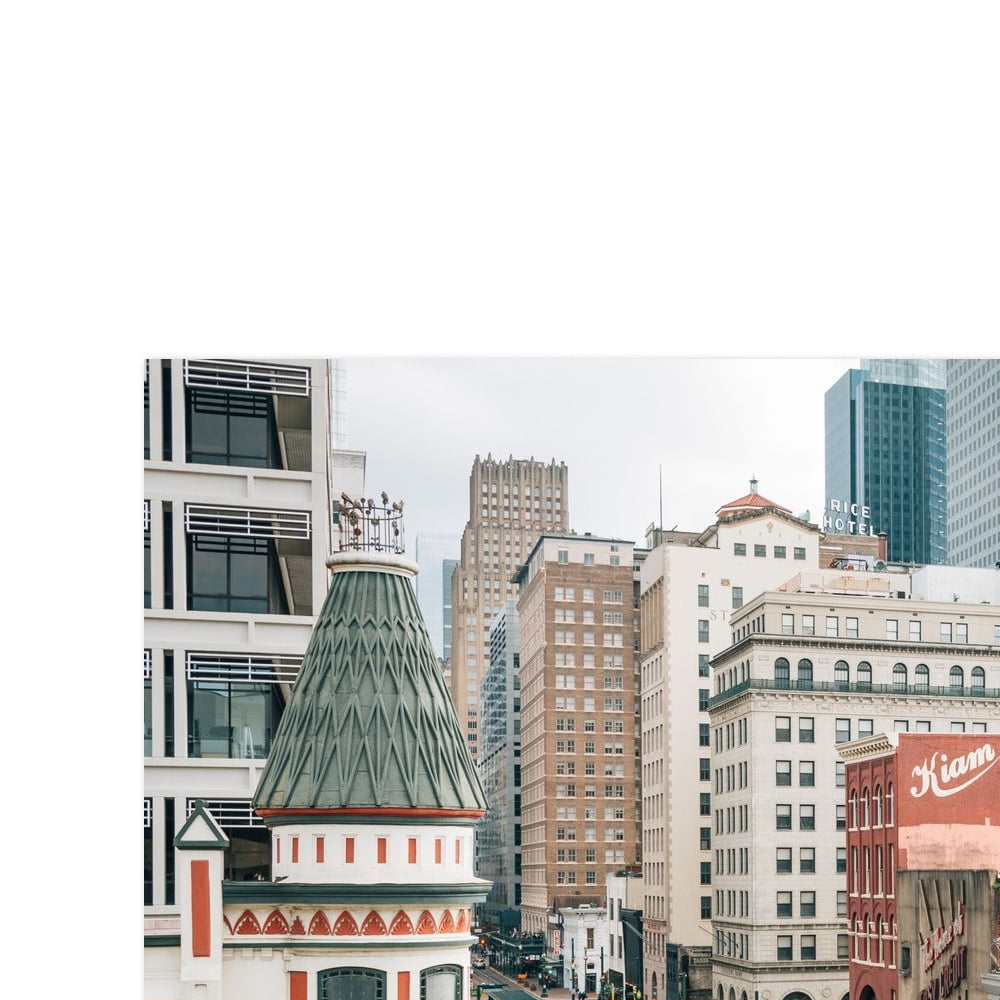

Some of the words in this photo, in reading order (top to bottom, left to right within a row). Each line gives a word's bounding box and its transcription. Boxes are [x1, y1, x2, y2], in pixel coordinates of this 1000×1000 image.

[823, 515, 879, 538] HOTEL
[830, 499, 870, 518] RICE
[910, 744, 1000, 798] Kiam
[940, 945, 968, 998] CREDIT
